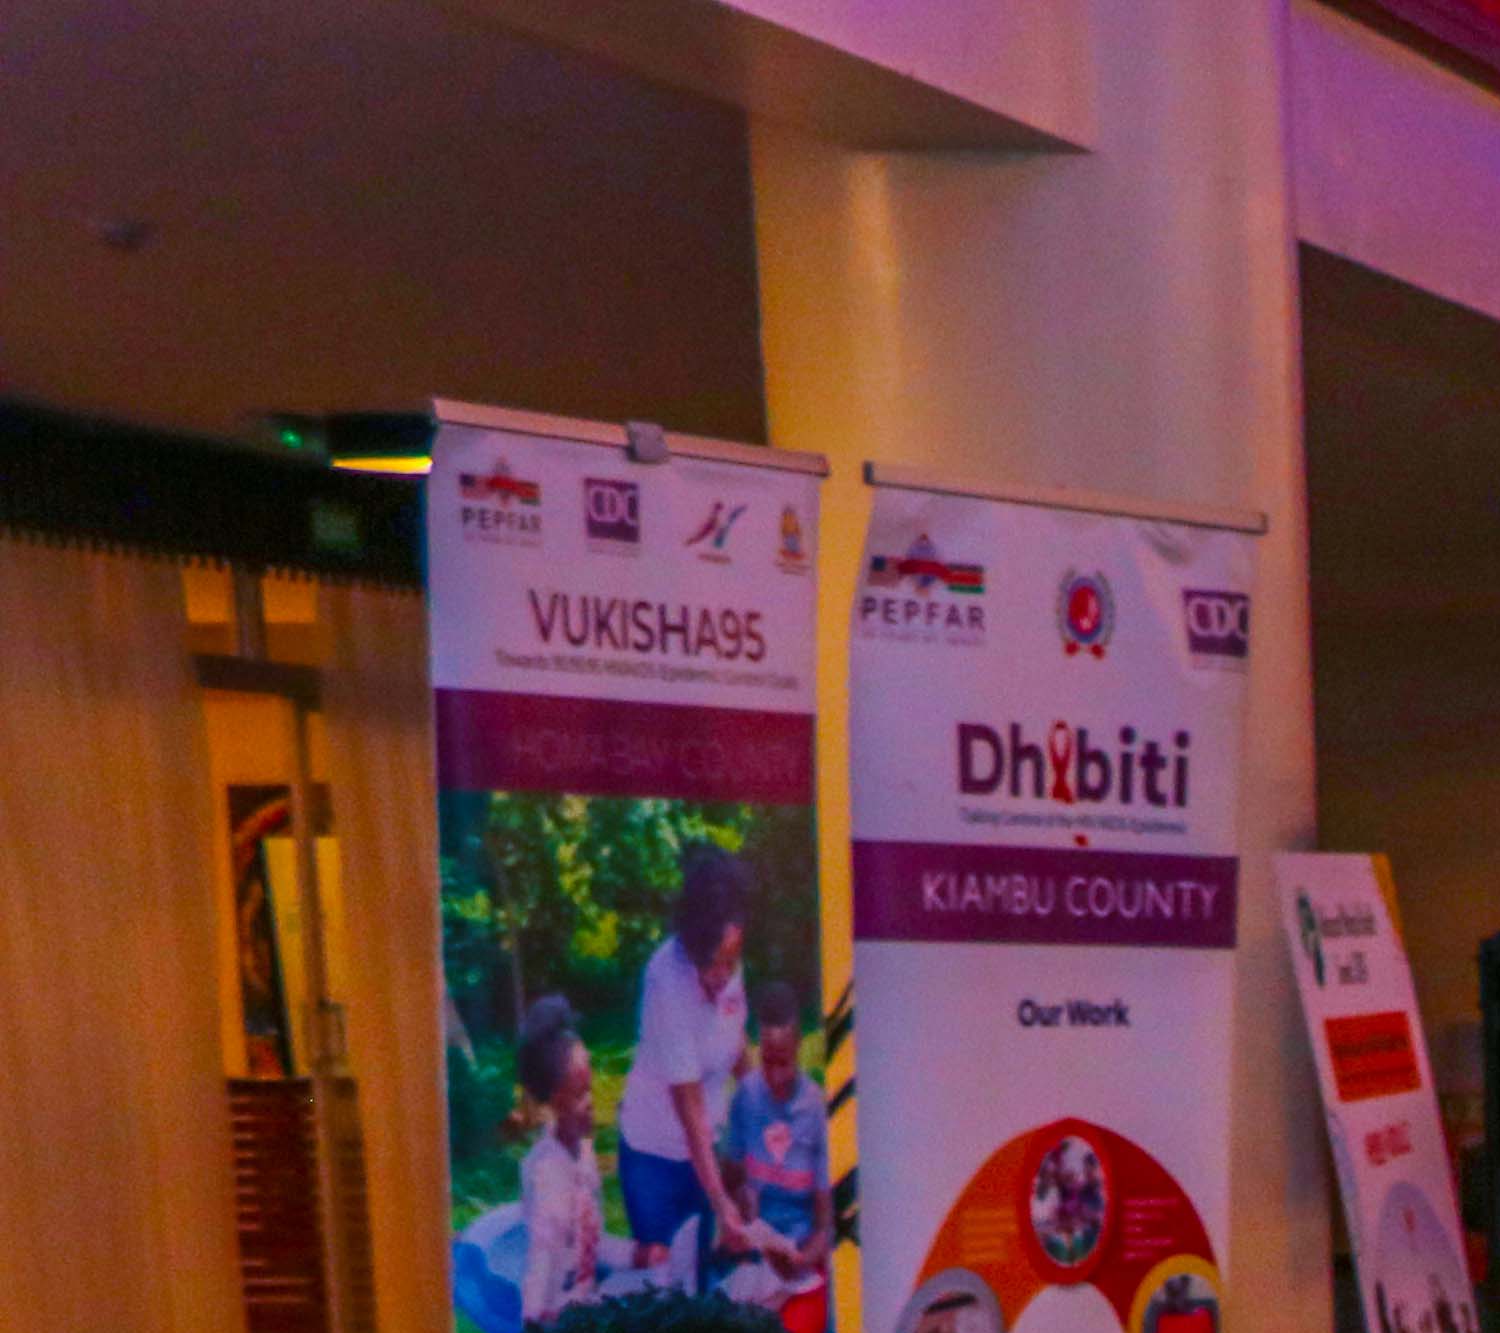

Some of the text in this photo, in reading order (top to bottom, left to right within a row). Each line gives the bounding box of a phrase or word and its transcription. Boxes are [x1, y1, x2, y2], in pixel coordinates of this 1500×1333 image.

[462, 507, 542, 532] PEPFAR
[528, 588, 767, 662] VUKISHA95
[861, 597, 985, 632] PEPFAR
[1188, 602, 1250, 639] CDC
[922, 872, 1220, 920] KIAMBU COUNTY
[1017, 999, 1130, 1028] Our Work
